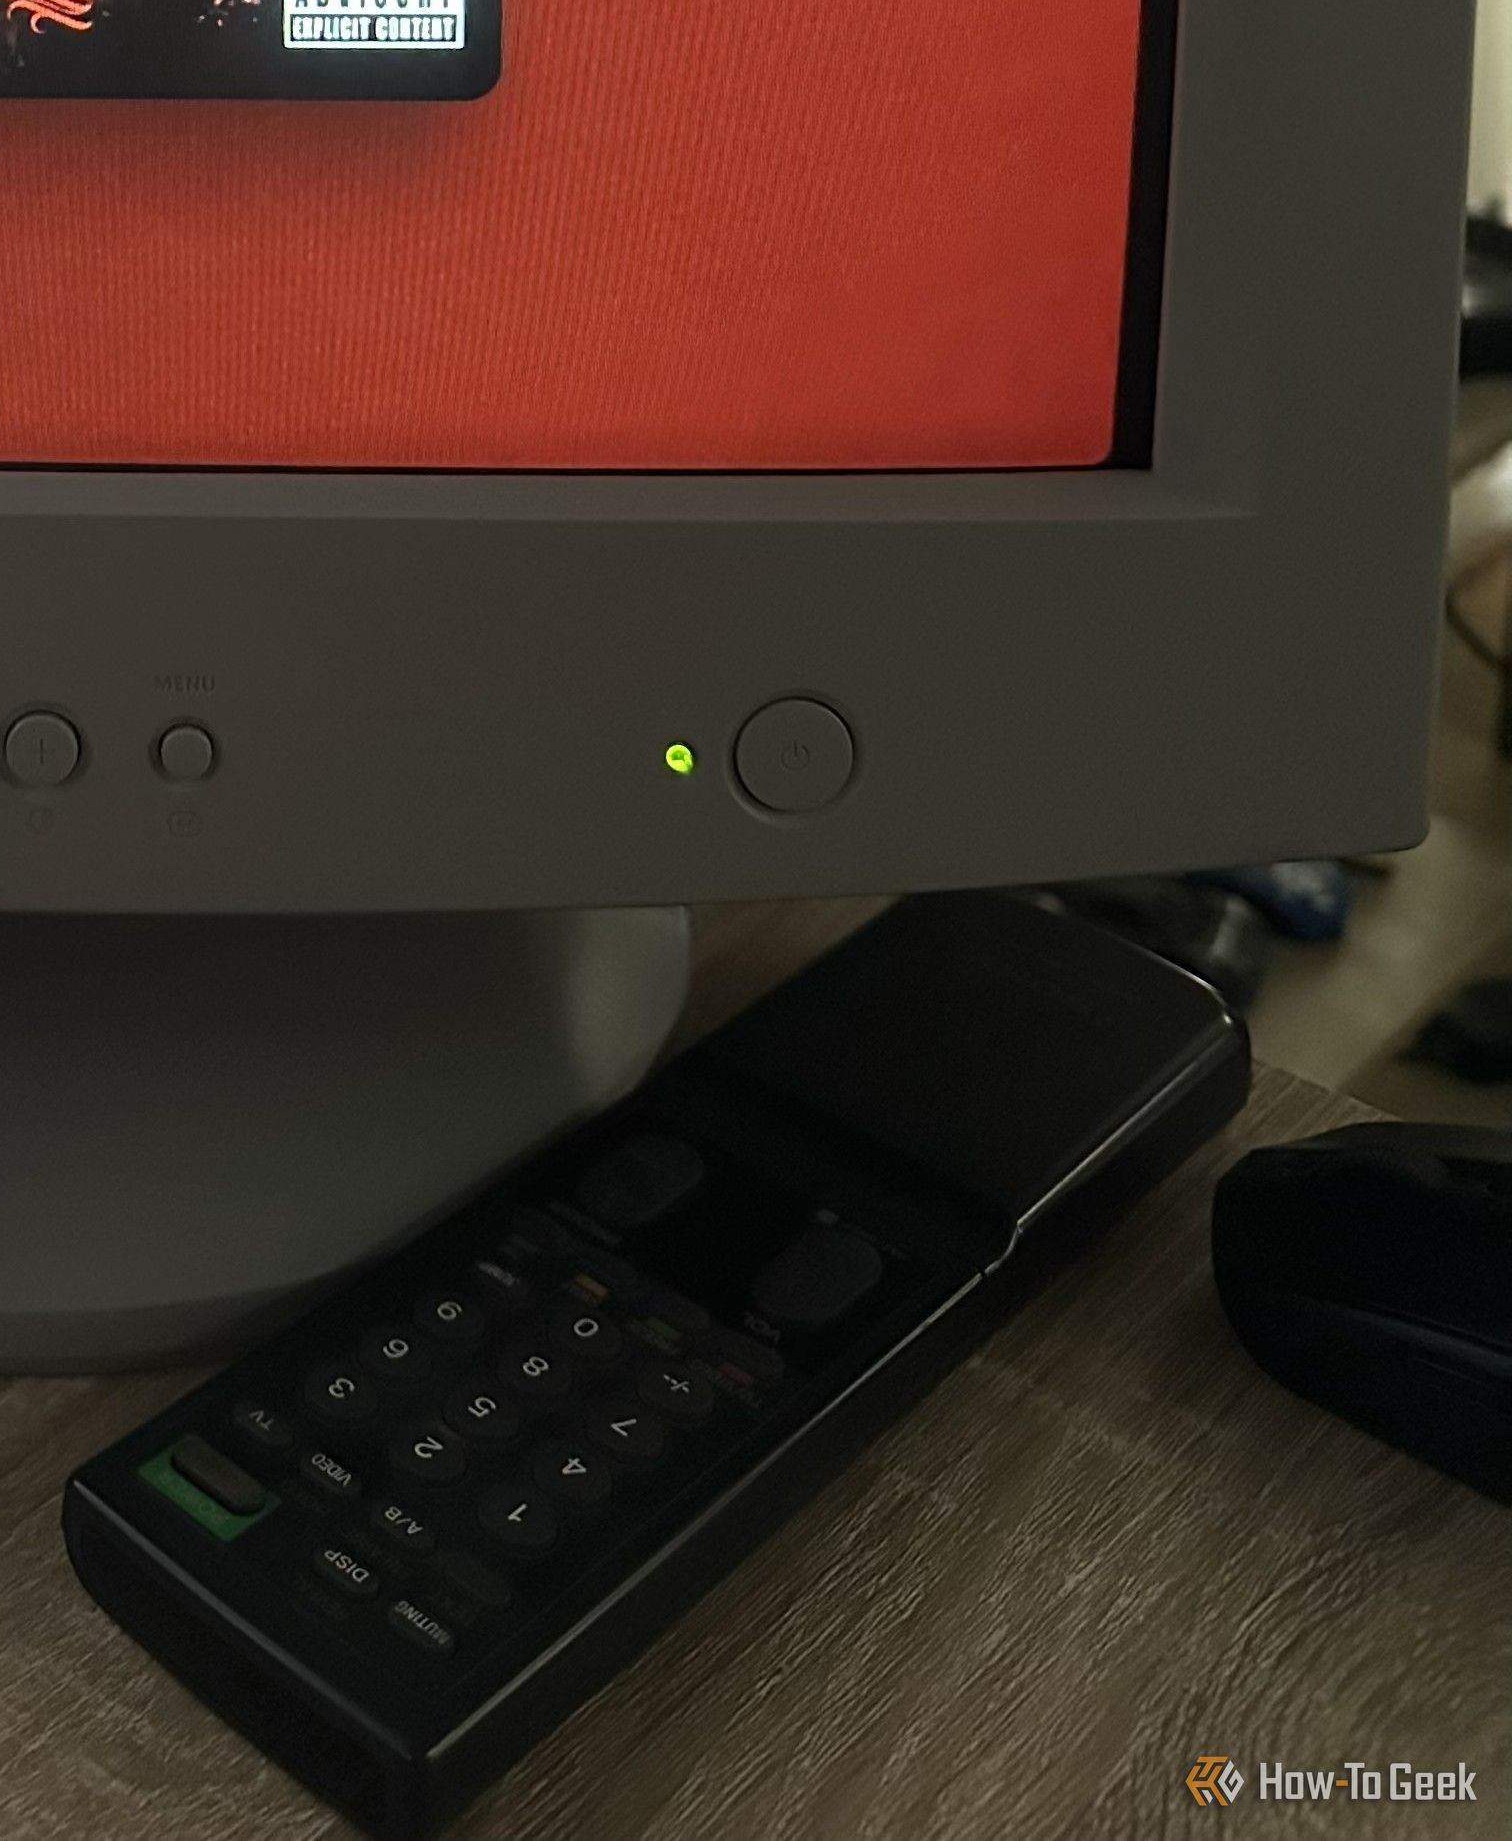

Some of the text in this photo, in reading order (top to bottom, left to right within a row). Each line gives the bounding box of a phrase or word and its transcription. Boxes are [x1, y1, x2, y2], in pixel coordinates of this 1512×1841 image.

[292, 16, 454, 40] EXPLICIT CONTENT
[153, 674, 216, 693] MENU
[437, 1301, 463, 1320] 9
[573, 1318, 599, 1337] 0
[382, 1339, 409, 1359] 6
[522, 1356, 549, 1377] 8
[328, 1377, 355, 1398] 3
[468, 1397, 497, 1418] 5
[249, 1409, 274, 1430] TV
[611, 1418, 637, 1437] 7
[414, 1436, 443, 1459] 2
[310, 1453, 353, 1487] VIDEO
[561, 1458, 587, 1475] 4
[384, 1505, 423, 1535] A/B
[507, 1503, 527, 1522] 1
[324, 1549, 370, 1583] DISP
[394, 1600, 452, 1646] MUTING
